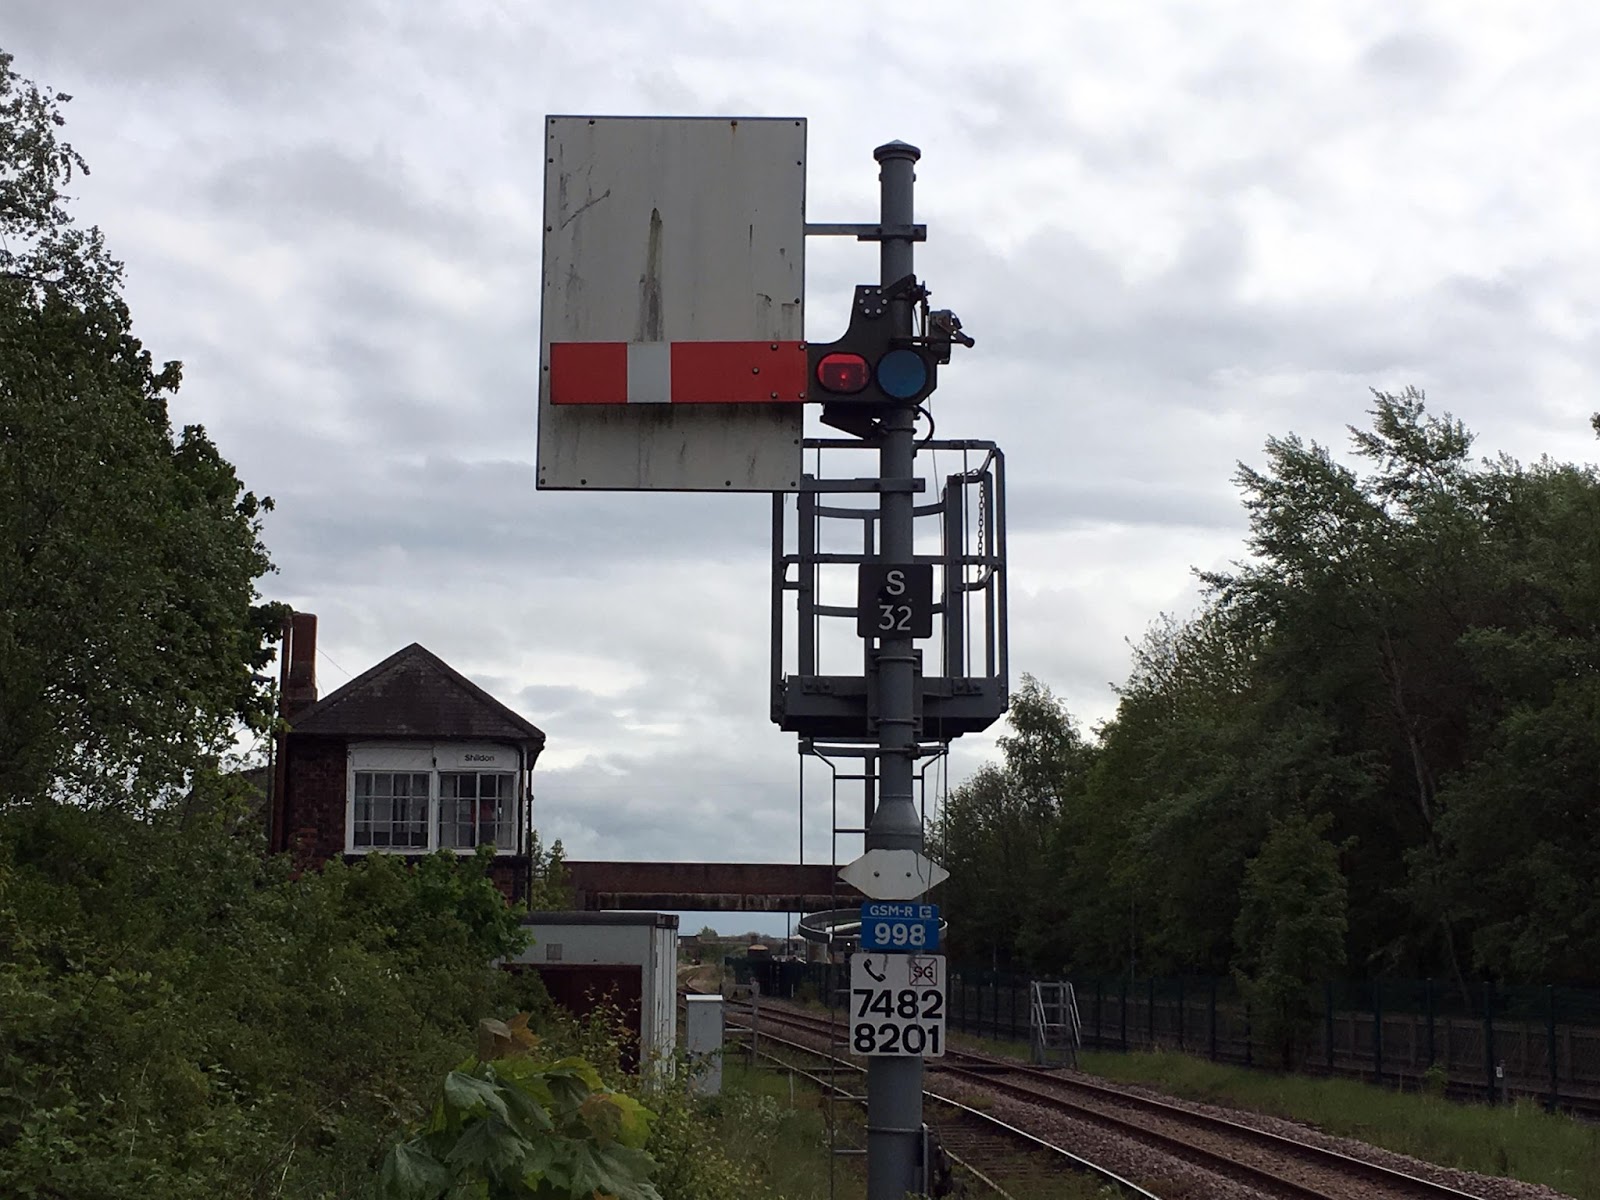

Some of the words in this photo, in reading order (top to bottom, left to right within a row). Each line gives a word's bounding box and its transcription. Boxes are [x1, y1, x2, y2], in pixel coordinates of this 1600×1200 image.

[886, 570, 906, 595] S
[878, 604, 912, 631] 32
[464, 753, 495, 762] Shildon
[869, 905, 913, 917] GSM-R
[874, 922, 926, 946] 998
[913, 966, 934, 978] SG
[853, 989, 943, 1019] 7482
[854, 1023, 939, 1054] 8201
